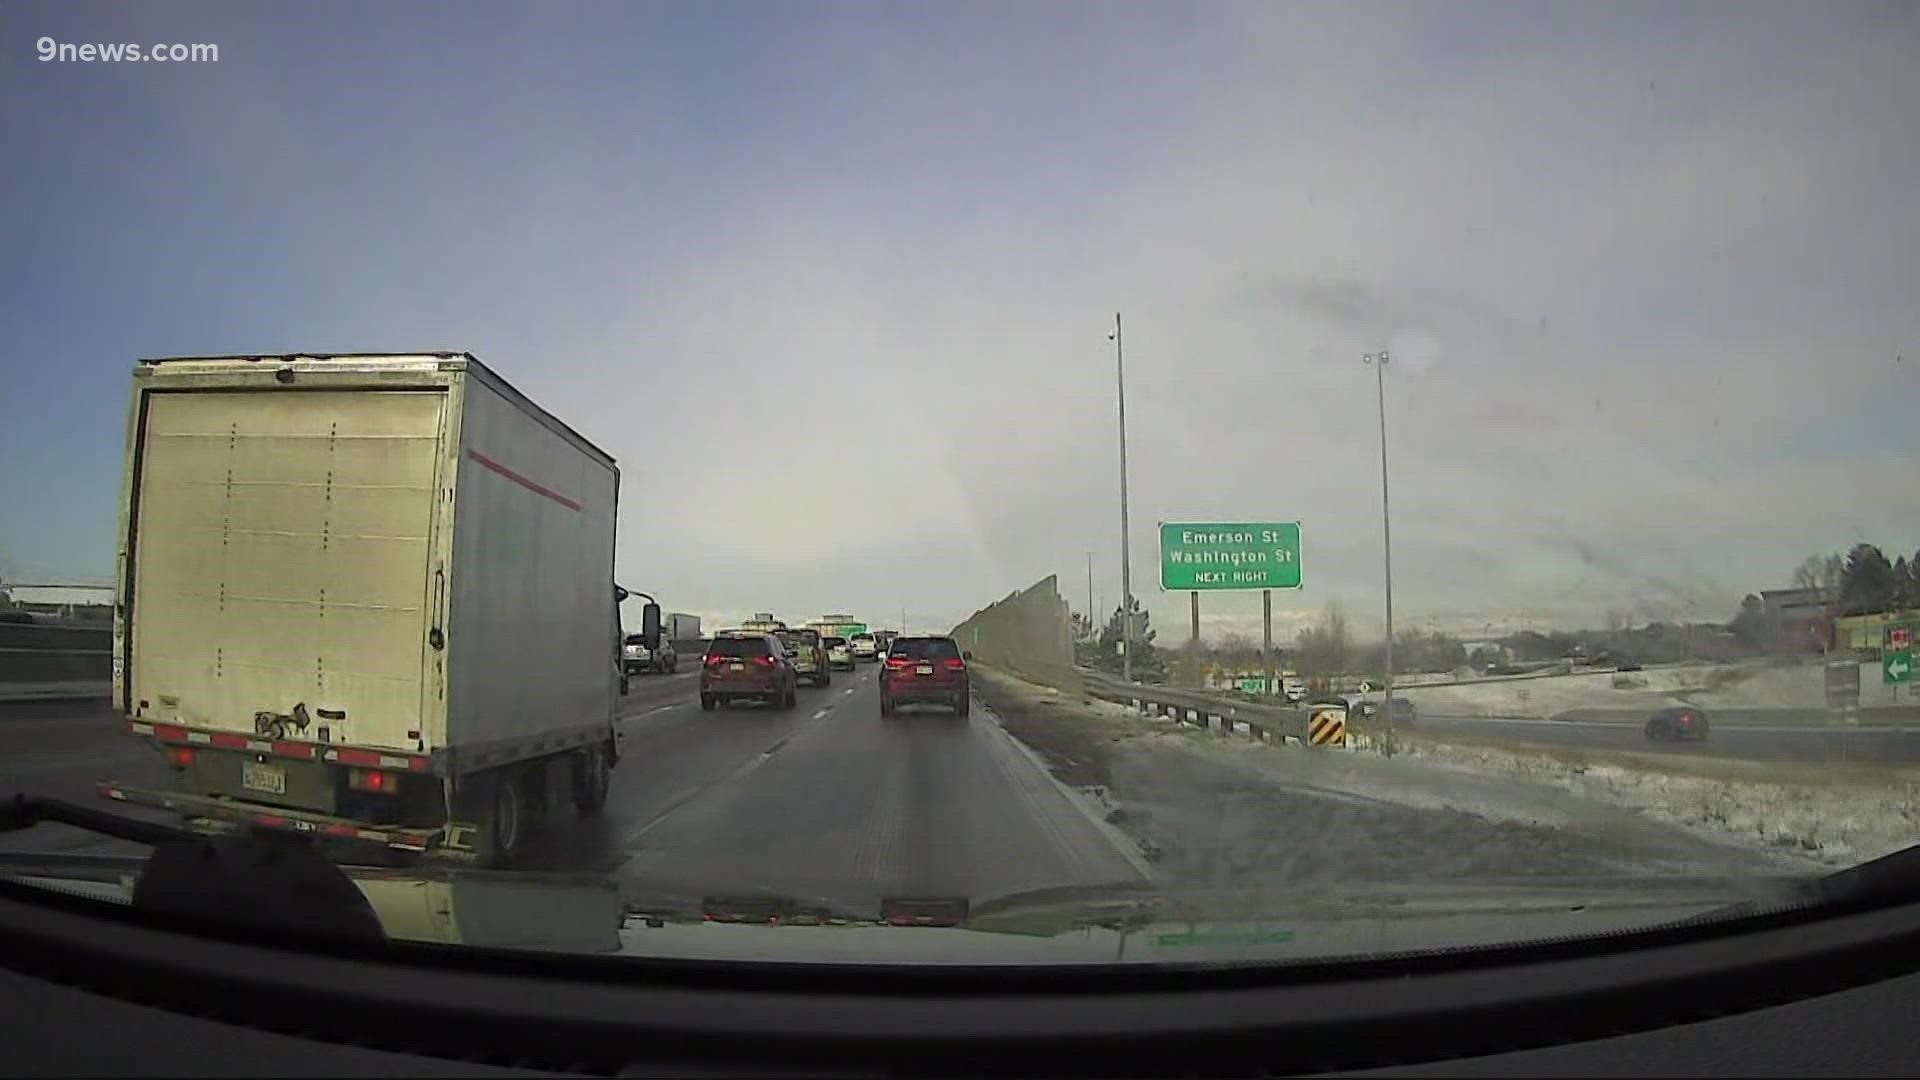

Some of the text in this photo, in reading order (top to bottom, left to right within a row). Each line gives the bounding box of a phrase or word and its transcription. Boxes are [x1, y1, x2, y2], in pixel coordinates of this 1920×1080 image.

[1182, 530, 1278, 544] Emerson St
[1170, 549, 1292, 566] Washington St
[1195, 571, 1268, 583] NEXT RIGHT
